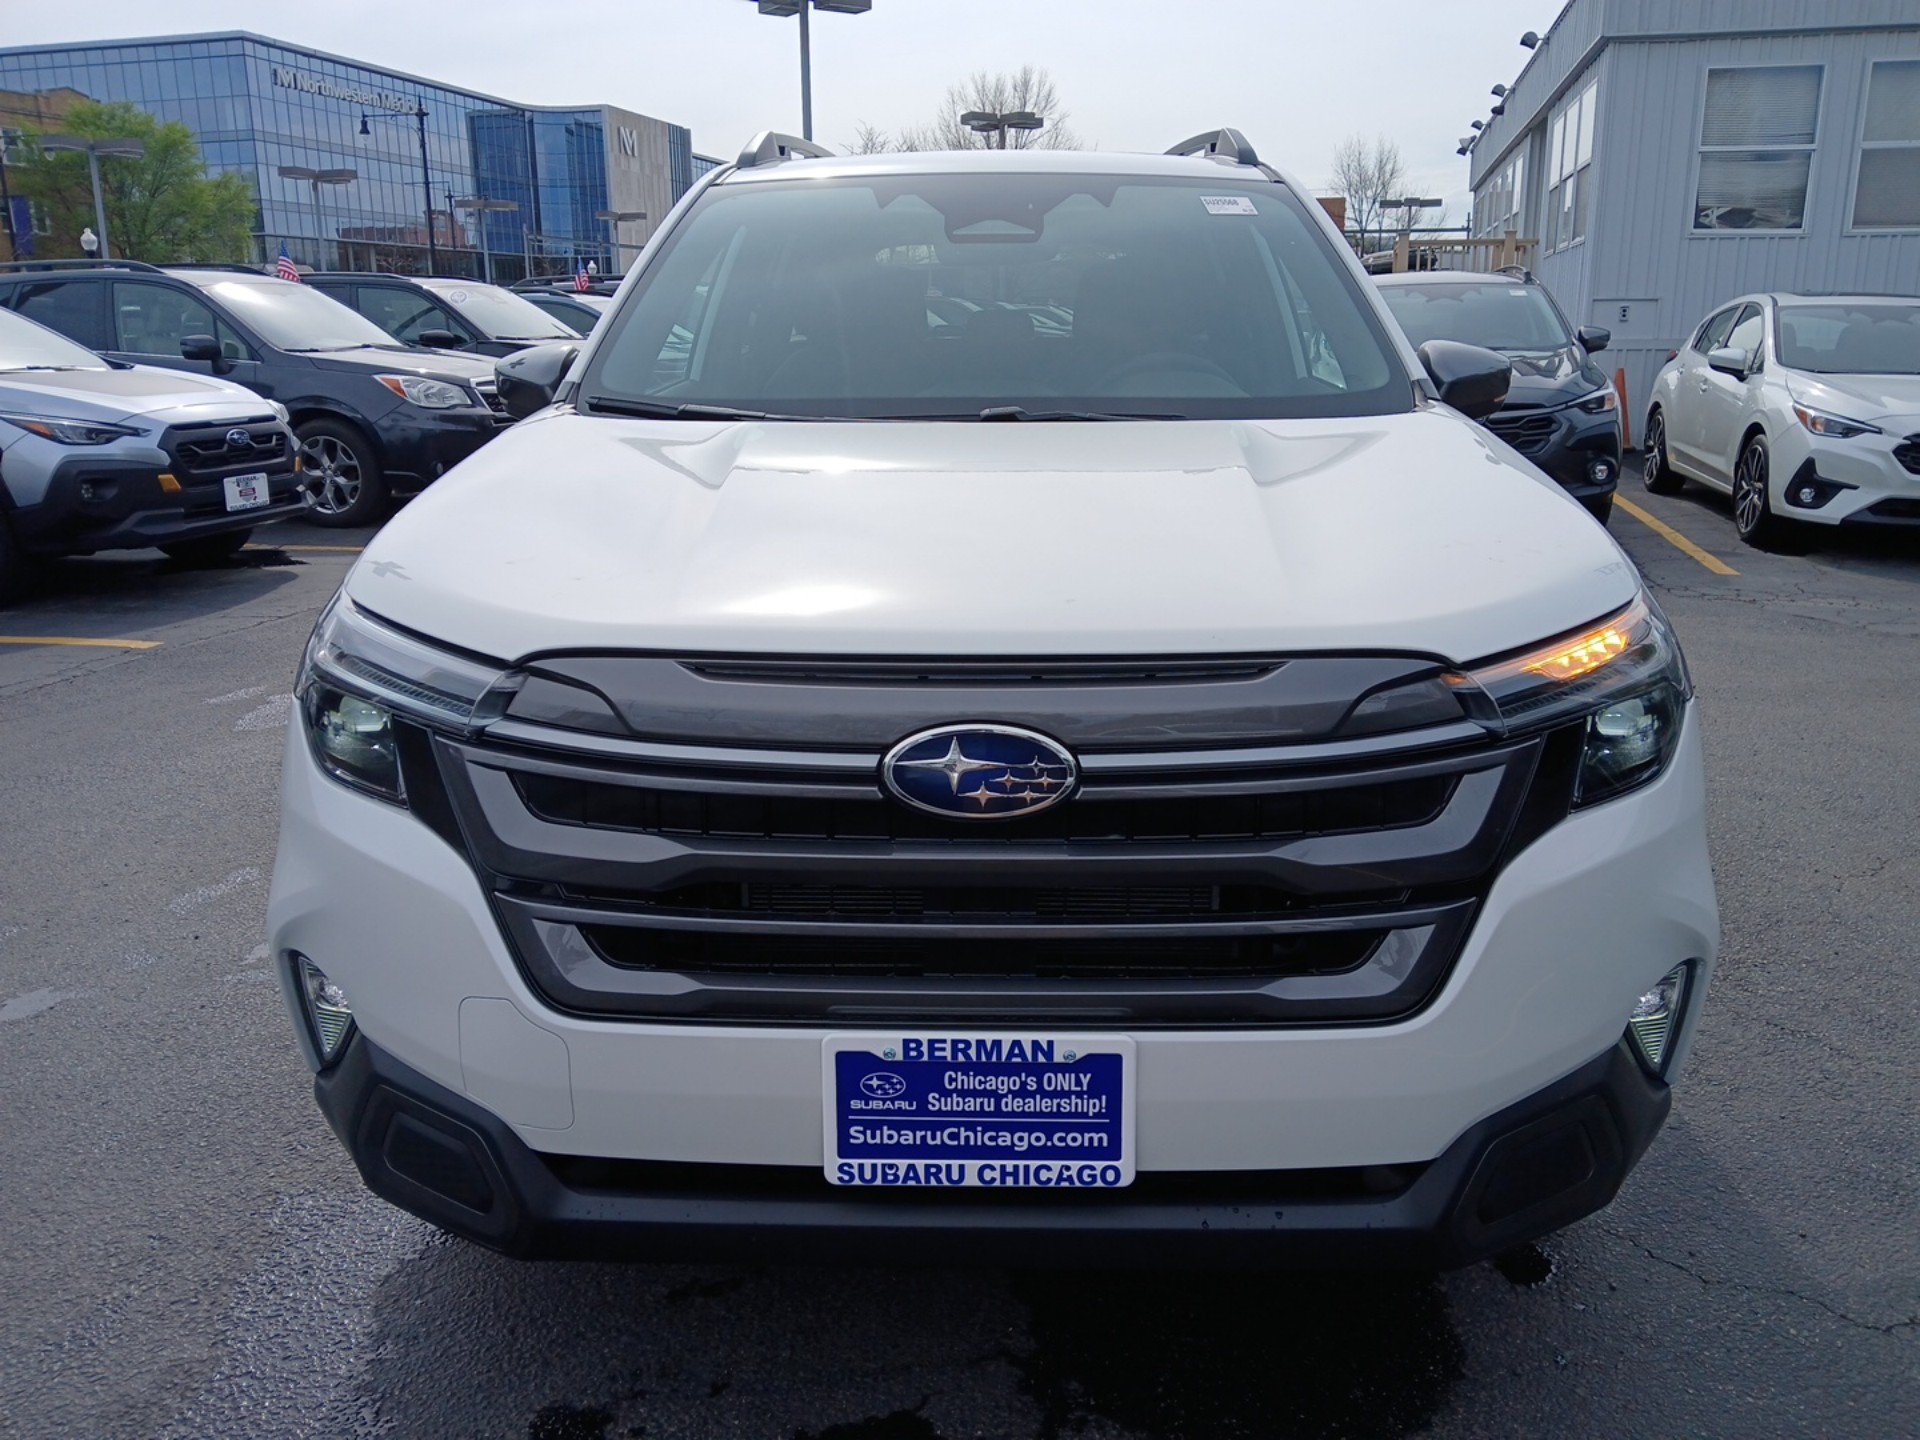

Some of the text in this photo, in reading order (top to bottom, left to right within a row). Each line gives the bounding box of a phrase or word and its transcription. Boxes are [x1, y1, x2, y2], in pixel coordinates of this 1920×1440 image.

[300, 73, 381, 108] Northwestern
[902, 1038, 1055, 1062] BERMAN
[944, 1071, 1092, 1094] Chicago's ONLY
[850, 1099, 917, 1110] SUBARU
[927, 1092, 1107, 1117] Subaru dealership!
[848, 1125, 1109, 1151] SubaruChicago.com
[836, 1162, 1122, 1187] SUBARU CHICAGO
